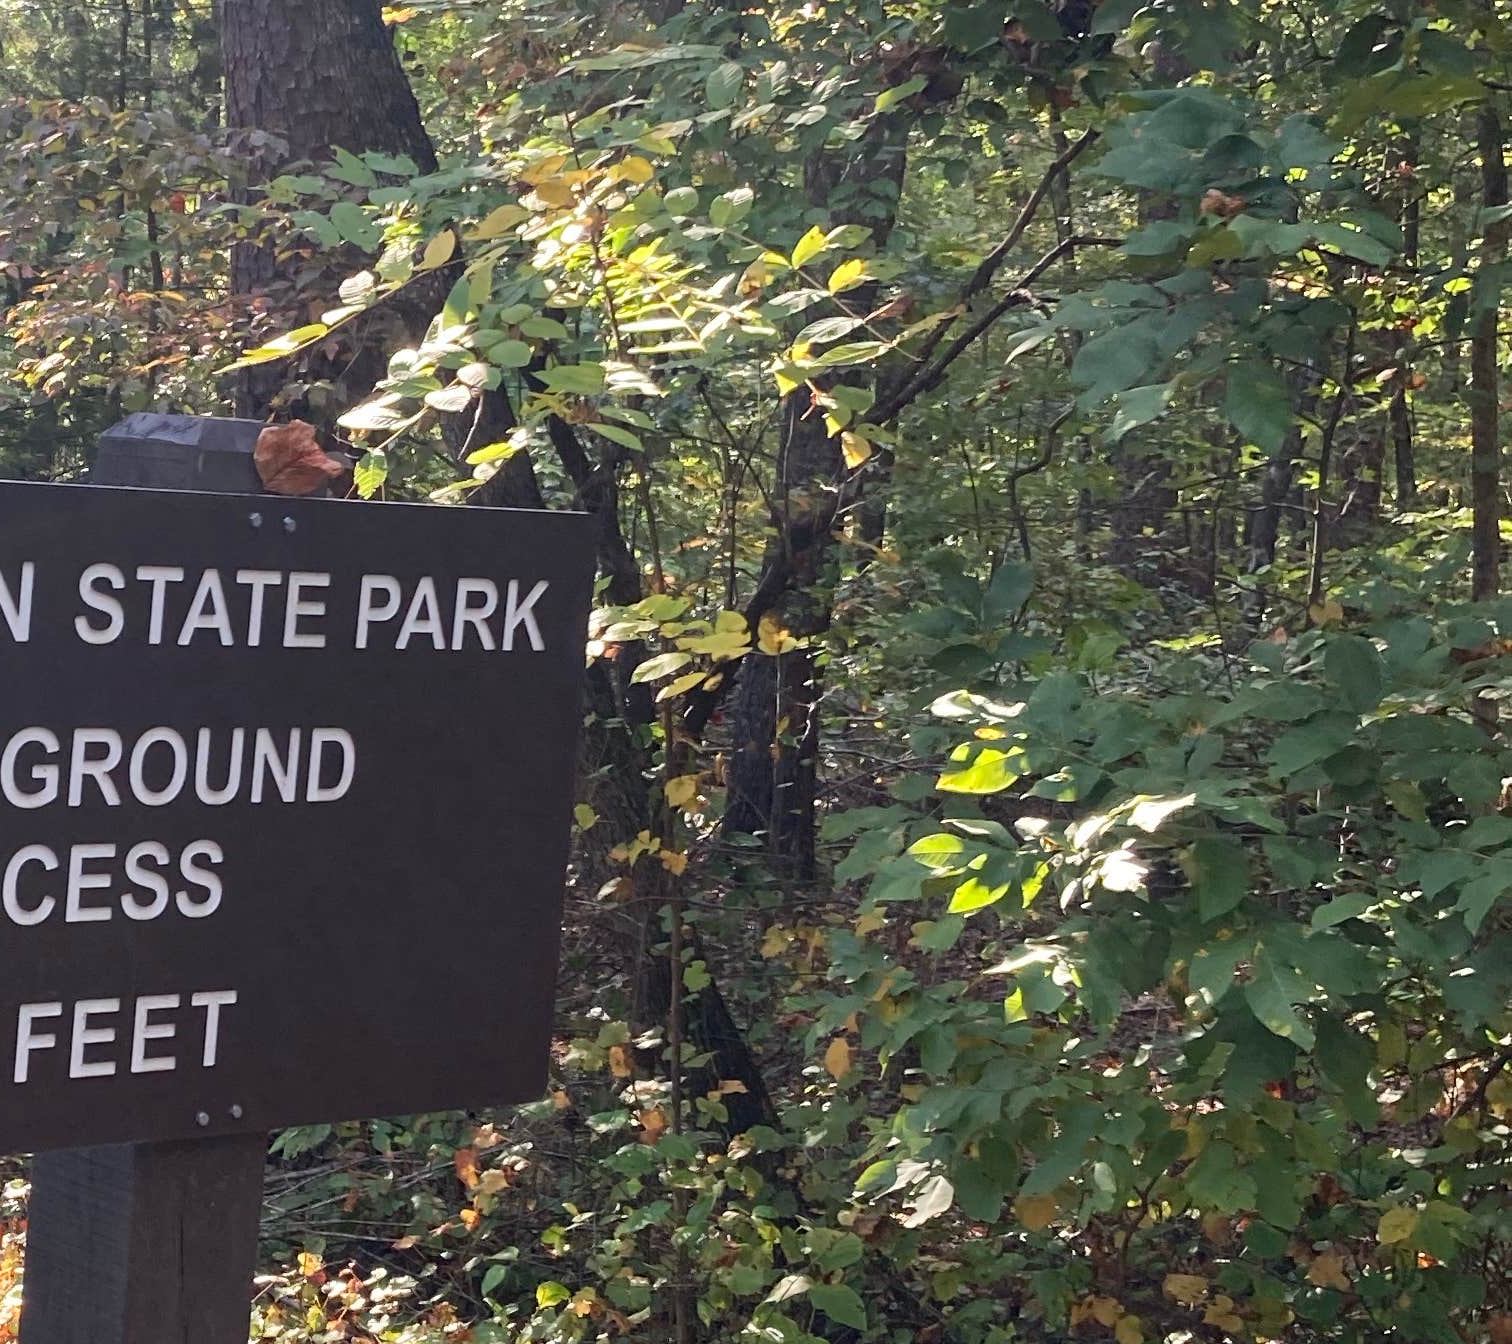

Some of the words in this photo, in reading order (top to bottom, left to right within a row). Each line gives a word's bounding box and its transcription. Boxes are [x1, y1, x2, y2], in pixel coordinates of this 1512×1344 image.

[75, 563, 330, 648] STATE
[356, 574, 549, 652] PARK
[14, 990, 238, 1083] FEET
